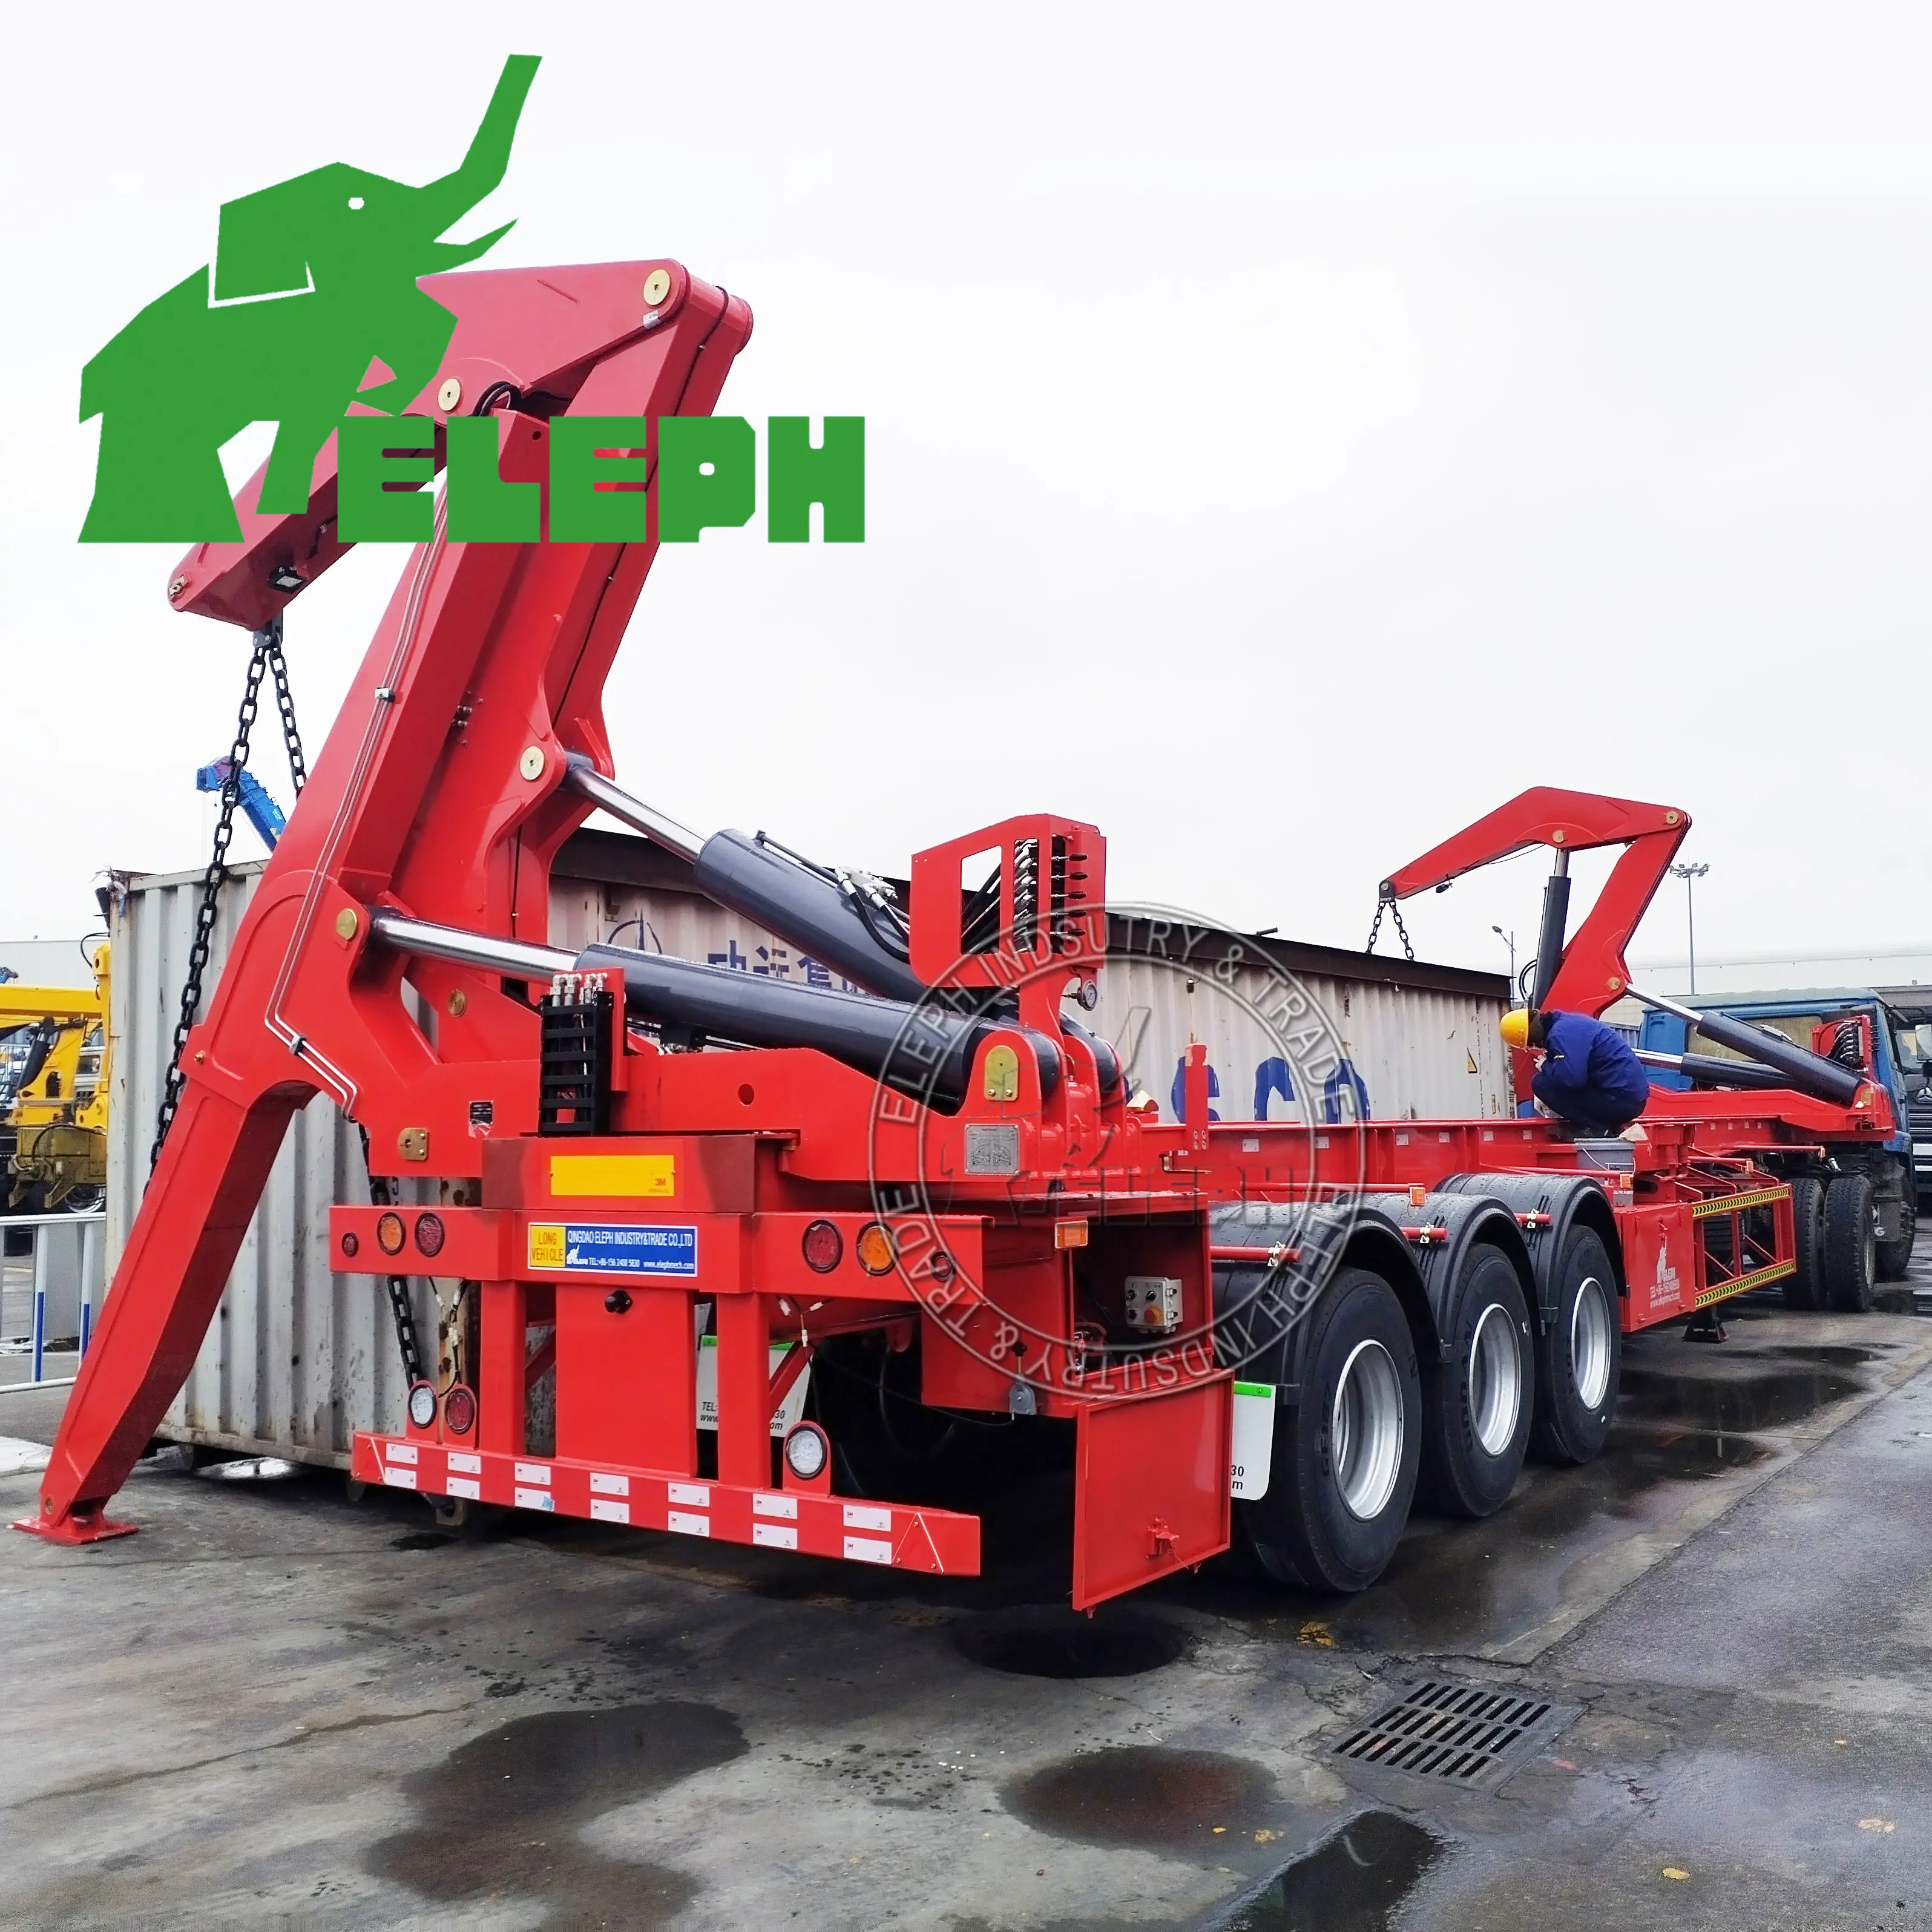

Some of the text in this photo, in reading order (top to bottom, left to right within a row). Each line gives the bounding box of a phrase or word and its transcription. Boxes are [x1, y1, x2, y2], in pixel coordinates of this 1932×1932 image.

[538, 1232, 557, 1244] LONG
[567, 1230, 594, 1244] QINGDAO
[595, 1231, 613, 1244] ELEPH
[531, 1247, 564, 1261] VEHICLE
[700, 1414, 719, 1423] www
[774, 1410, 786, 1419] 30
[1231, 1465, 1244, 1477] 30
[1232, 1480, 1244, 1490] m
